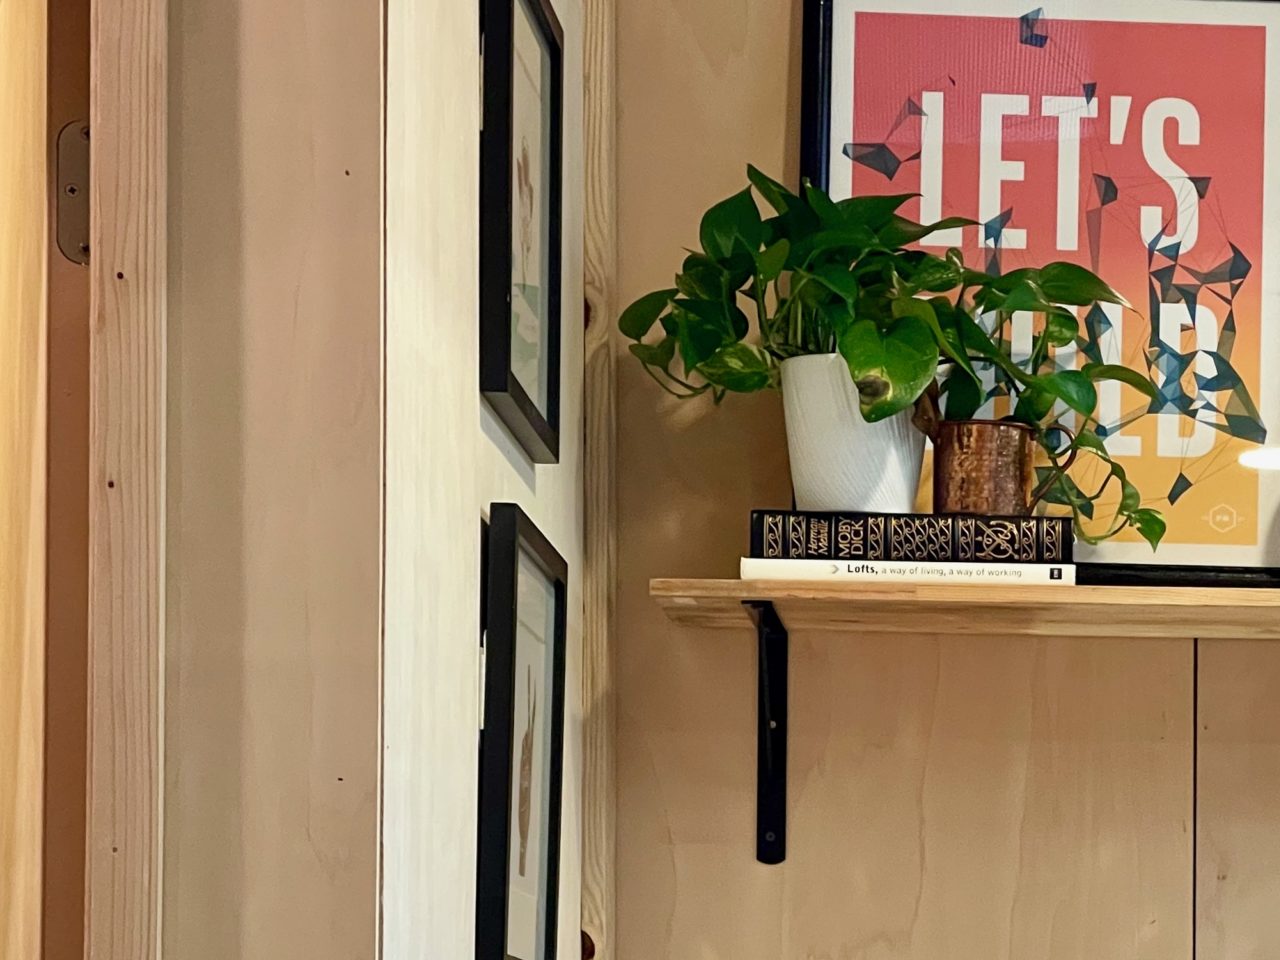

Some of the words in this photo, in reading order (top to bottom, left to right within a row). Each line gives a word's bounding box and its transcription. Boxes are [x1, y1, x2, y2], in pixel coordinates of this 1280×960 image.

[919, 90, 1201, 256] LET'S
[807, 518, 818, 555] Herman
[818, 519, 829, 555] Melville
[838, 516, 851, 557] MOBY
[851, 519, 864, 555] DICK
[847, 564, 879, 575] Lofts,
[889, 567, 906, 576] way
[909, 566, 919, 575] of
[921, 566, 946, 577] living,
[956, 568, 974, 577] way
[976, 568, 985, 576] of
[987, 568, 1022, 578] working
